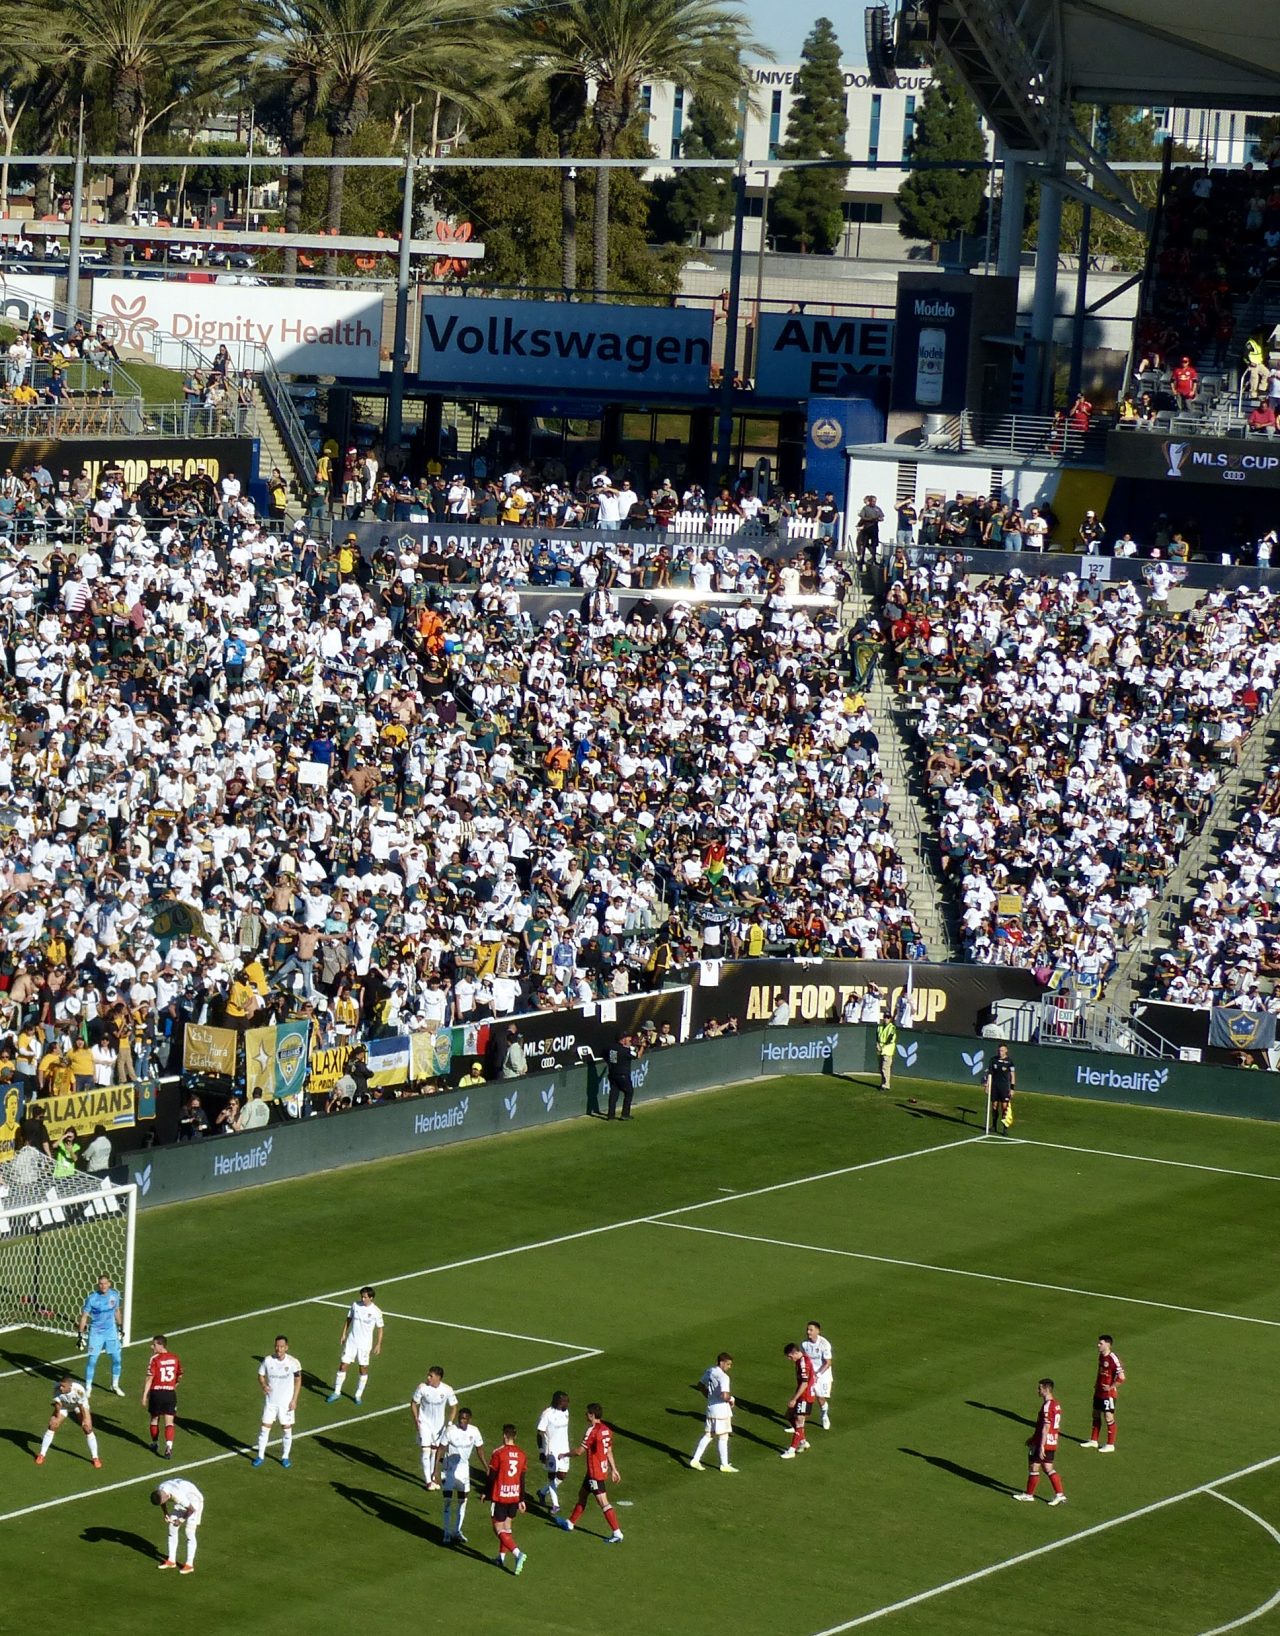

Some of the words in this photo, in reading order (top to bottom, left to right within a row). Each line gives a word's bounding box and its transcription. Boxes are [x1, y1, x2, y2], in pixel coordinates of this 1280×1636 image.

[914, 299, 955, 317] Modelo
[172, 313, 274, 347] Dignity
[280, 318, 372, 347] Health
[772, 319, 896, 357] AME
[424, 314, 711, 373] Volkswagen
[1192, 452, 1228, 467] MLS
[1242, 455, 1280, 470] CUP
[1088, 563, 1105, 573] 127
[1058, 1011, 1074, 1020] EXIT
[523, 1040, 545, 1057] MLS
[552, 1034, 576, 1052] CUP
[761, 1041, 831, 1060] Herbalife
[1077, 1065, 1161, 1093] Herbalife
[144, 1087, 150, 1099] 6
[414, 1106, 465, 1135] Herbalife
[213, 1146, 267, 1177] Herbalife
[159, 1366, 175, 1382] 13
[507, 1459, 518, 1477] 3
